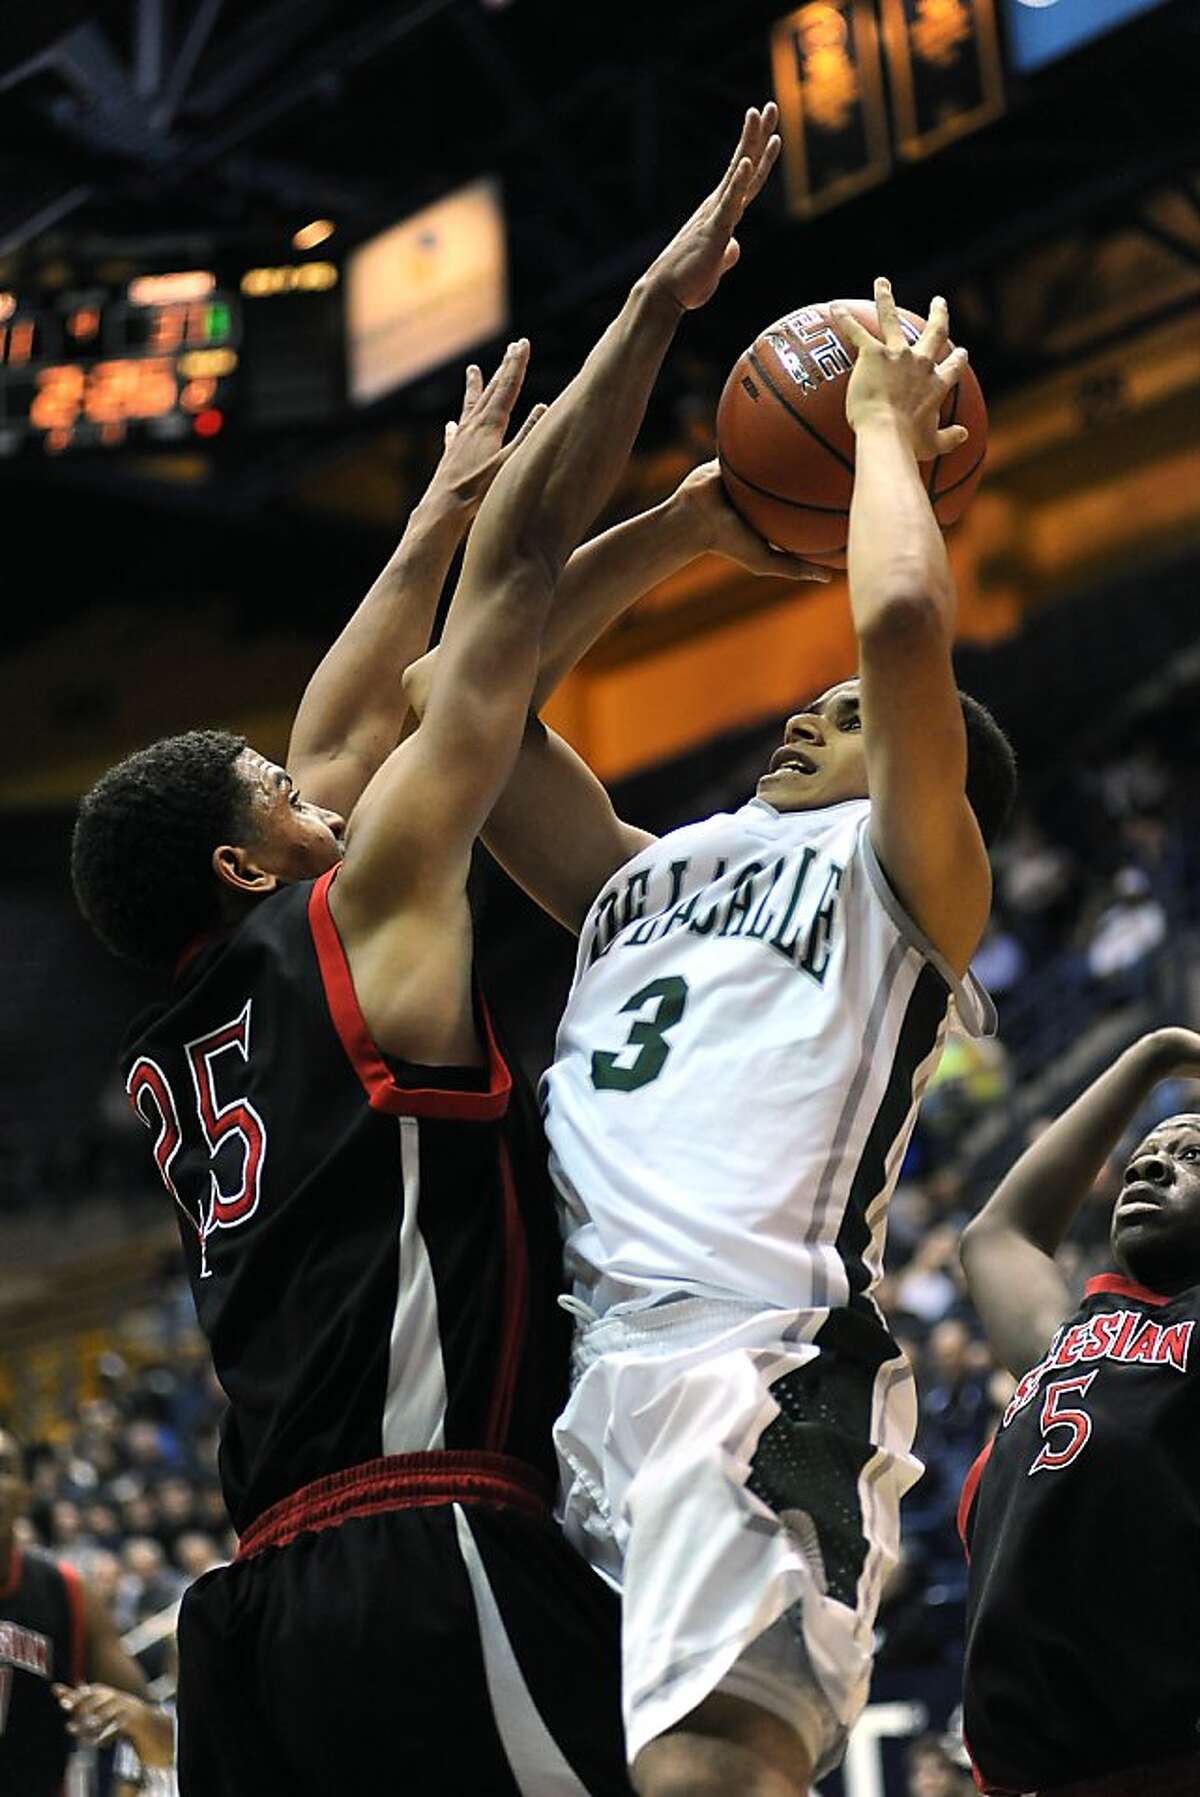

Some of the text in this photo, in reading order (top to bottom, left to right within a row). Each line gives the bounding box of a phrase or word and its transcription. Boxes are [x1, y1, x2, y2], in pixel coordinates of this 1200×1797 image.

[590, 975, 689, 1093] 3
[126, 998, 267, 1278] 25
[1027, 1367, 1100, 1476] 5
